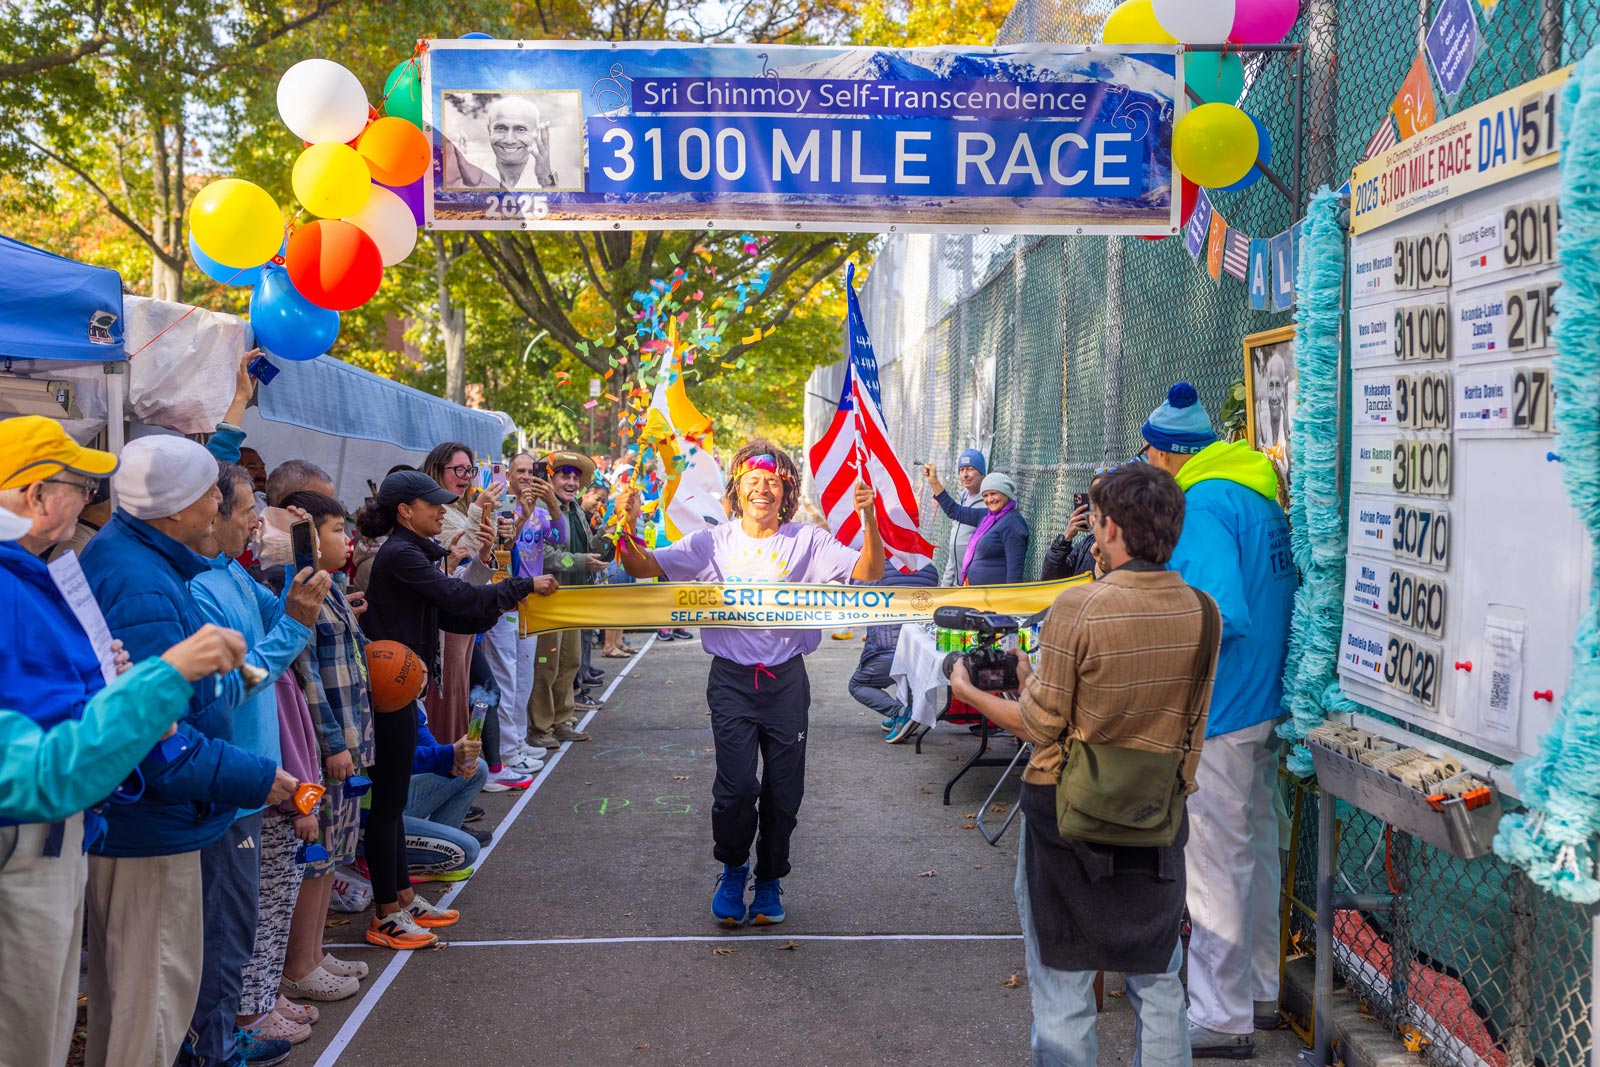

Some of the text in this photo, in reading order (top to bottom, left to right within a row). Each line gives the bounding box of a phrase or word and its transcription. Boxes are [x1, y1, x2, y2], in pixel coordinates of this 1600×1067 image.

[1440, 12, 1453, 36] Alex
[1440, 19, 1470, 75] champion-
[1445, 25, 1456, 45] our
[644, 82, 1086, 112] Sri Chinmoy Self-Transcendence
[602, 127, 1132, 185] 3100 MILE RACE
[1393, 147, 1413, 165] Chinmoy
[1413, 121, 1467, 154] Self-Transcendence
[1478, 94, 1555, 173] DAY 51
[1355, 133, 1472, 217] 2025 3,100 MILE RACE
[485, 195, 549, 219] 2025
[1459, 226, 1495, 245] Lucong Geng
[1504, 205, 1562, 264] 301
[1356, 261, 1372, 275] Andrea
[1394, 231, 1450, 288] 3100
[1394, 307, 1446, 358] 3100
[1365, 397, 1393, 414] Janczak
[1396, 376, 1446, 427] 3100
[1464, 383, 1504, 400] Harita Davies
[1360, 442, 1449, 490] Alex Ramsey 3100
[1360, 510, 1375, 524] Adrian
[1393, 506, 1446, 561] 3070
[1361, 566, 1375, 581] Milan
[670, 610, 836, 622] SELF-TRANSCENDENCE
[838, 611, 869, 619] 3100
[678, 590, 718, 606] 2025
[723, 588, 763, 607] SRI
[774, 589, 896, 608] CHINMOY
[1387, 571, 1443, 631] 3060
[1348, 633, 1367, 651] Daniela
[1384, 638, 1435, 703] 3022
